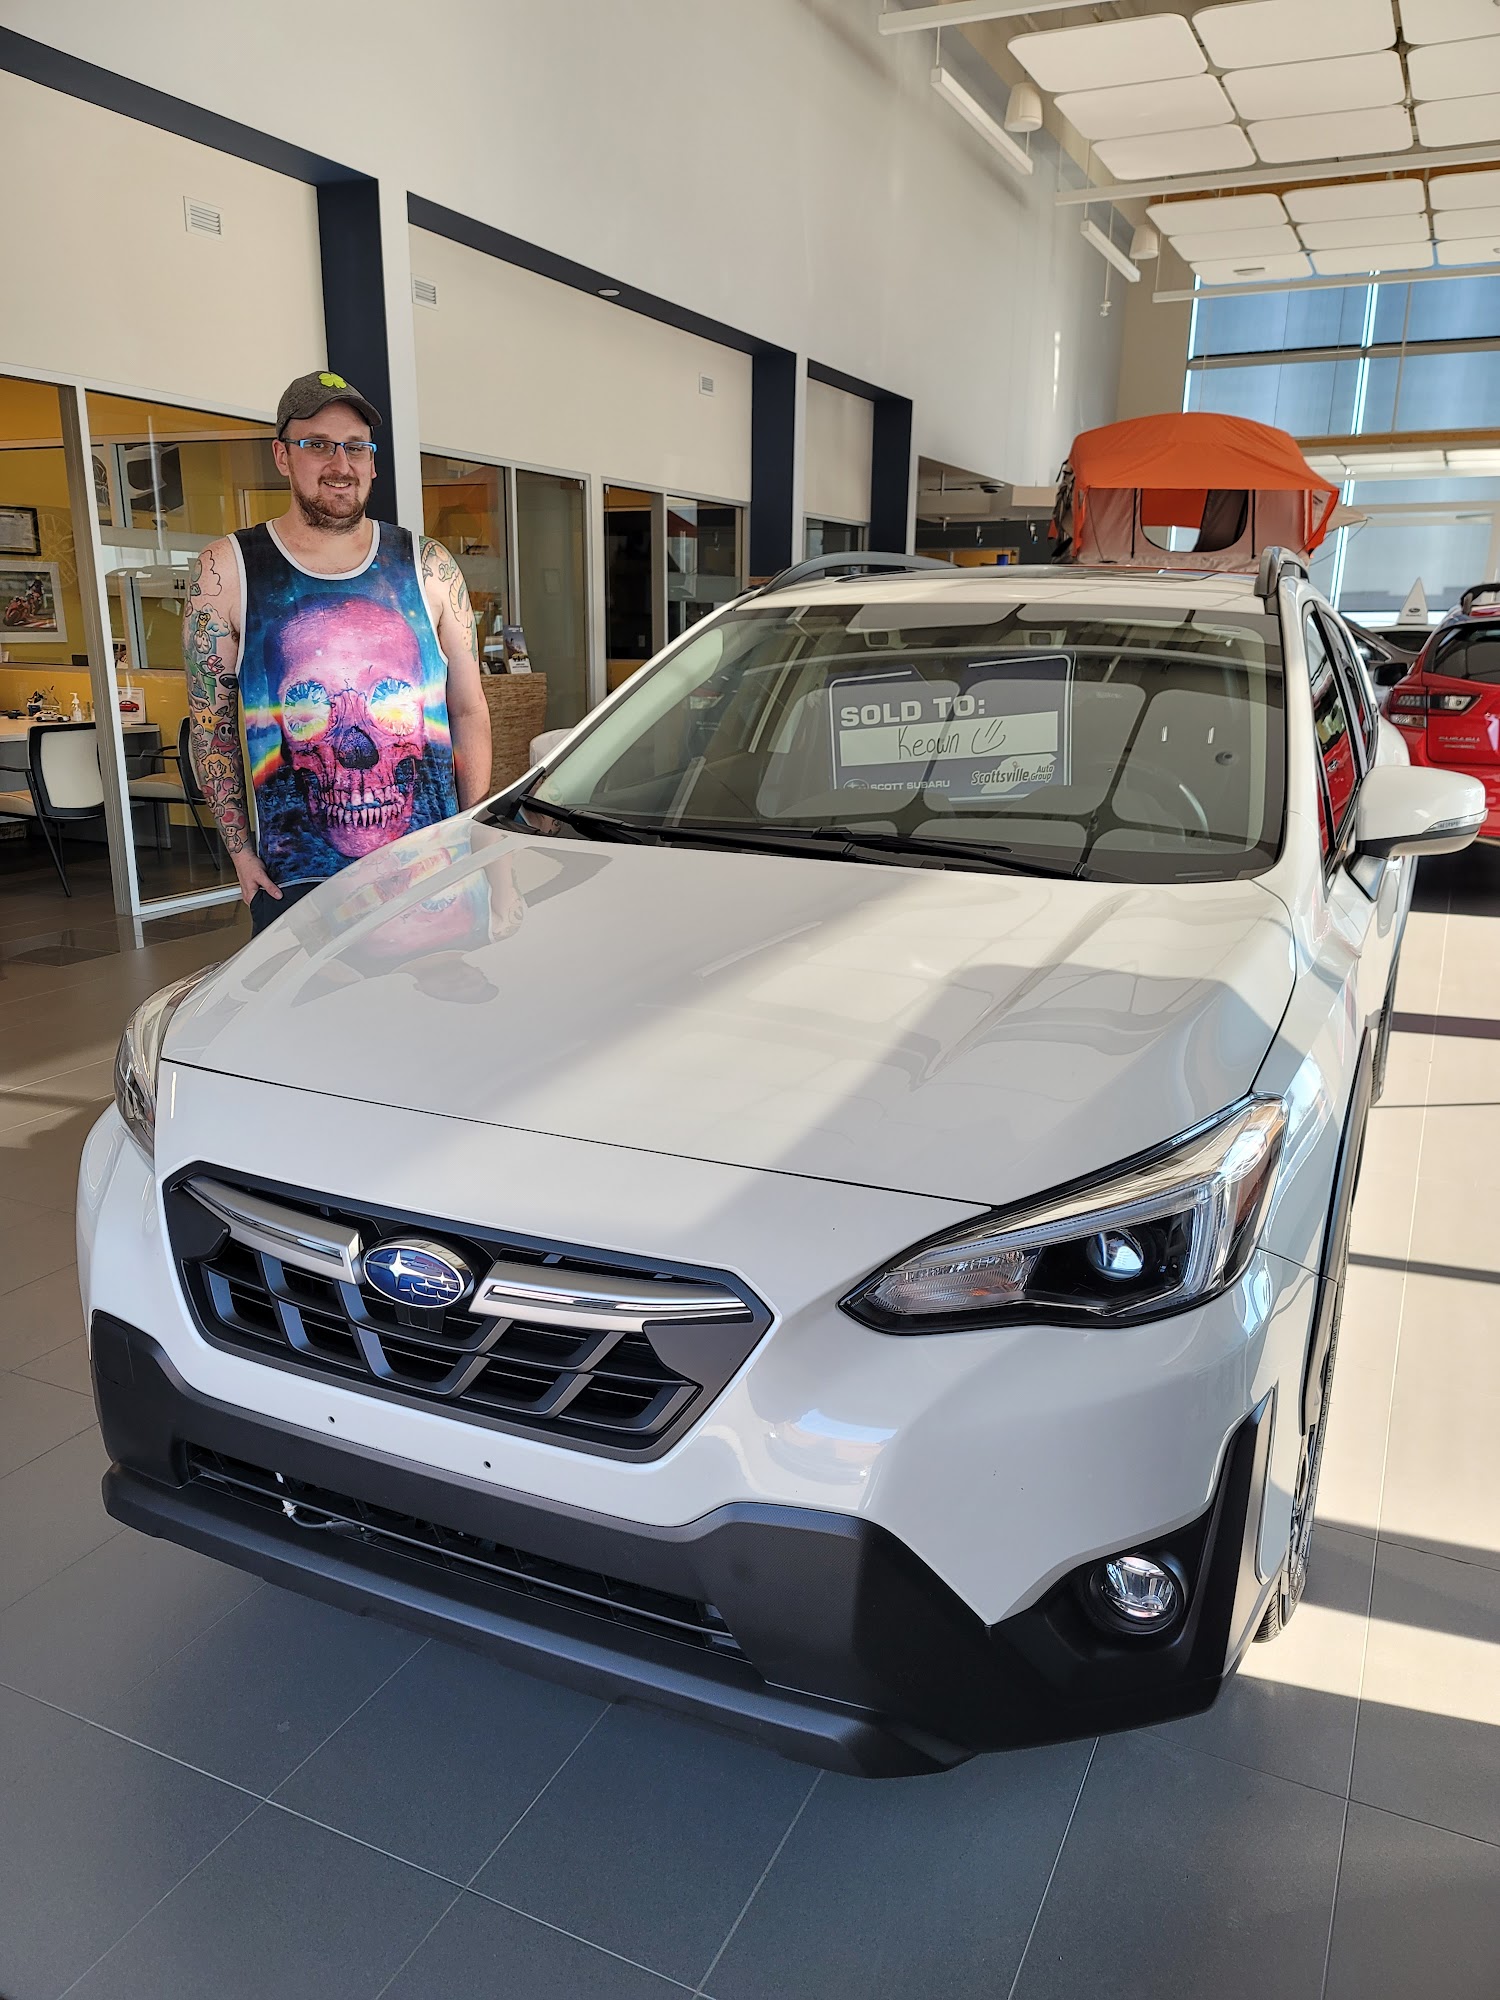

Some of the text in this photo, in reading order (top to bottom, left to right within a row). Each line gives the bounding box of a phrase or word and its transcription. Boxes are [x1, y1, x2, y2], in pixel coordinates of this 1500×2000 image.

[840, 694, 985, 727] SOLD TO:
[1036, 765, 1054, 773] Auto
[971, 767, 1030, 785] Scottsville
[1030, 772, 1052, 783] Group
[870, 780, 950, 791] SCOTT SUBARU
